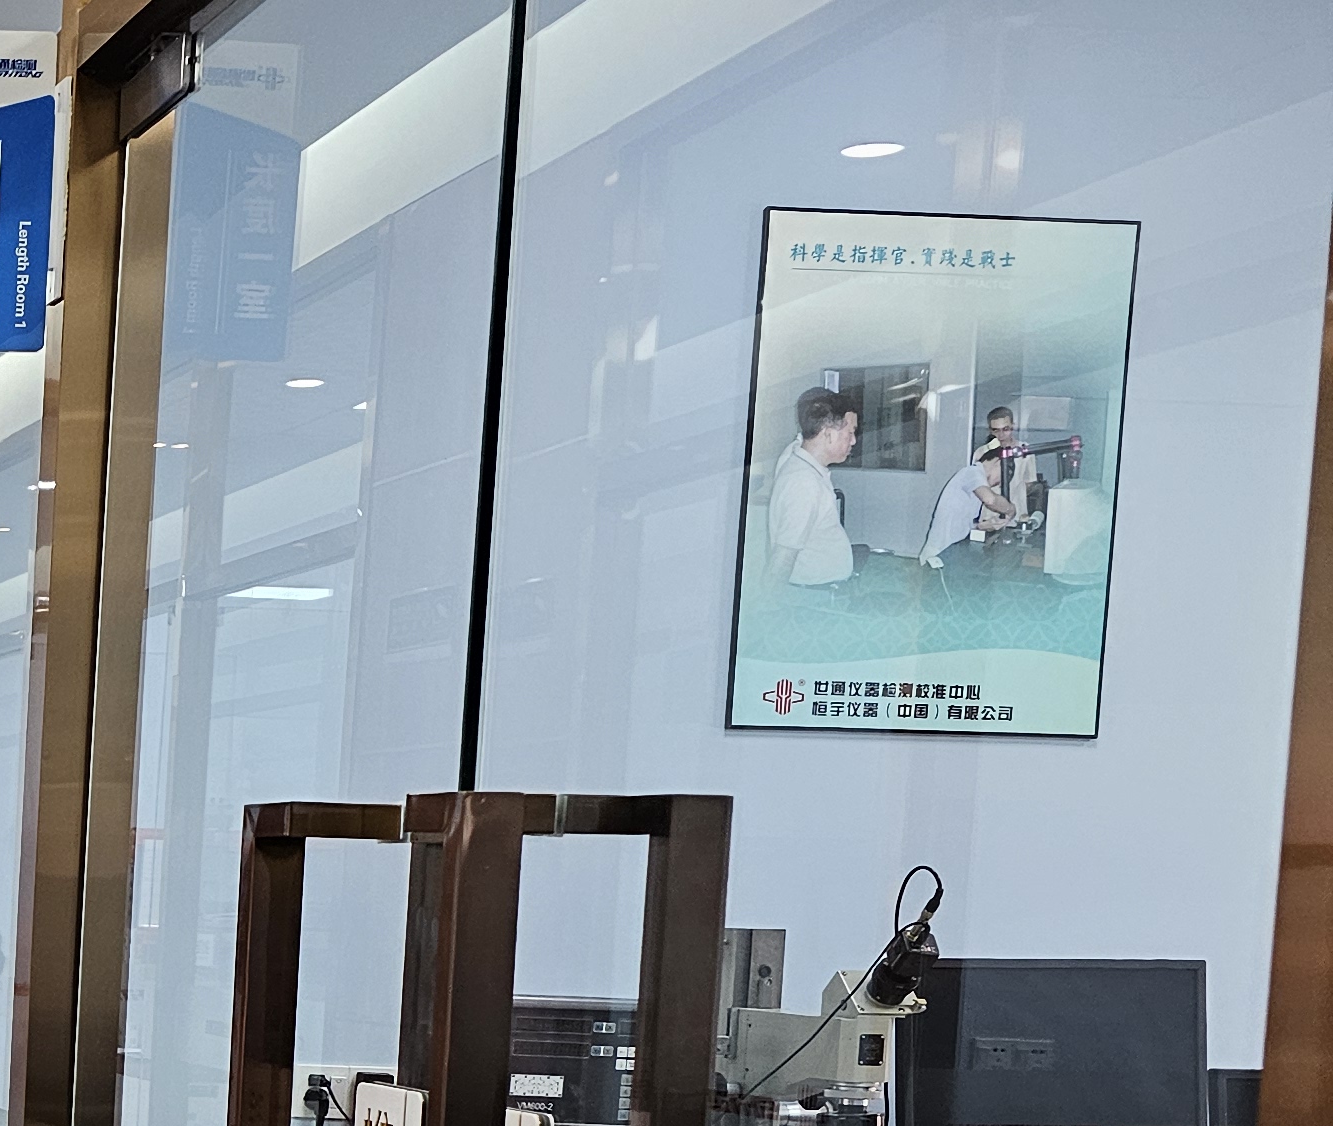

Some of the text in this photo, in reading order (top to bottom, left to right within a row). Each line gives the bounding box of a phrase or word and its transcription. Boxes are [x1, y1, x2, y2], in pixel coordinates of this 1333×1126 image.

[14, 220, 32, 271] Length
[15, 273, 30, 319] Room
[813, 680, 981, 701] 世通仪器检测校准中心
